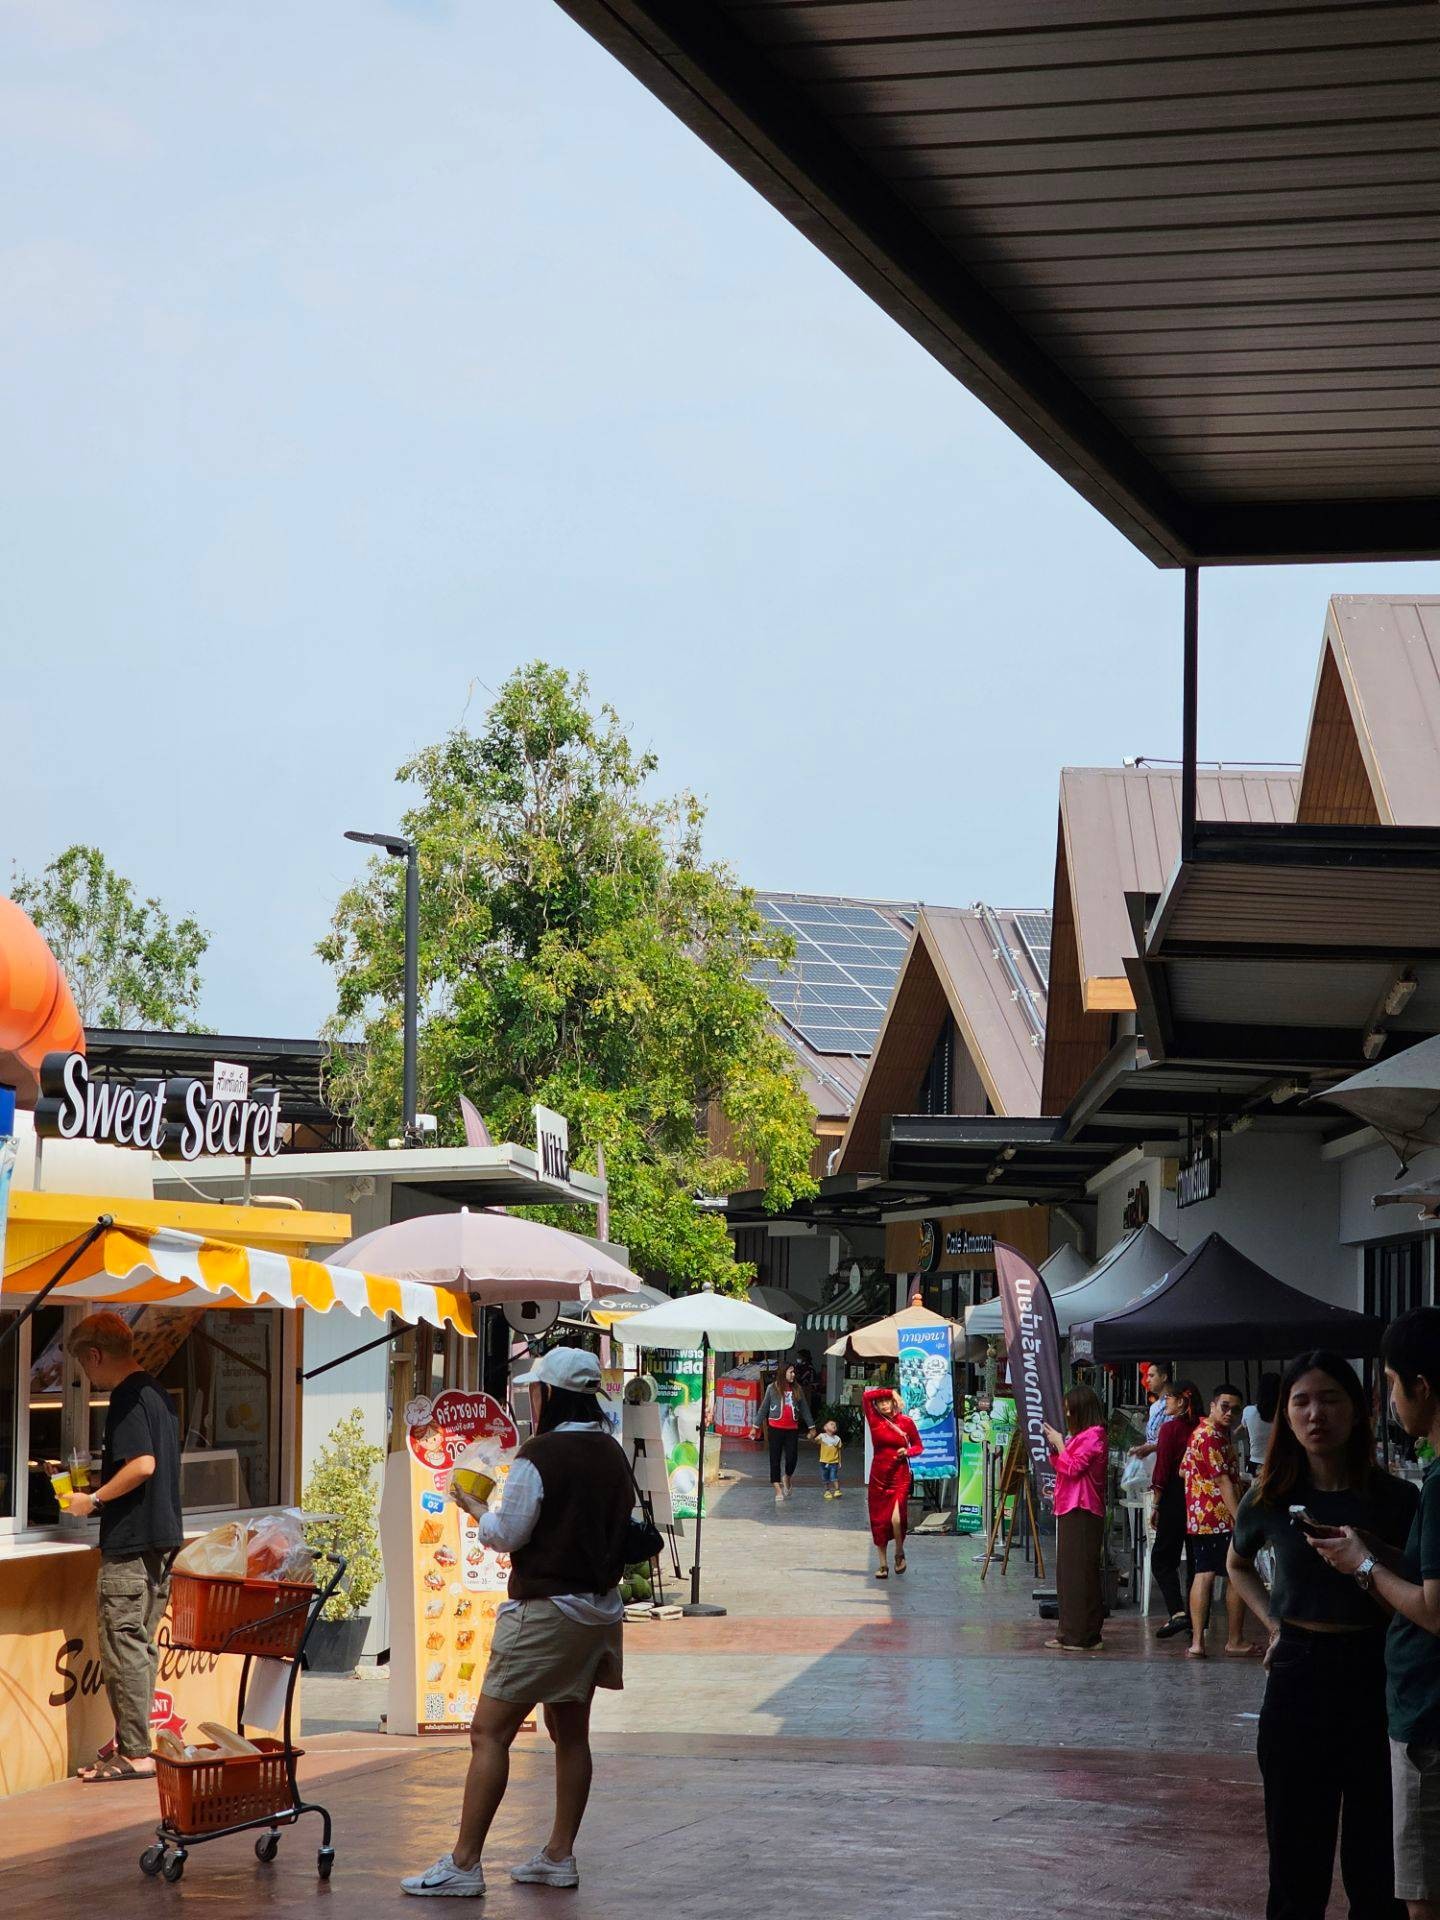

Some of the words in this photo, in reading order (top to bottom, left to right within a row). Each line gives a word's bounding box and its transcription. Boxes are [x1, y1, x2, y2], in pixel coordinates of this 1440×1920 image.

[58, 1053, 167, 1150] Sweet
[181, 1080, 282, 1161] Secret
[946, 1229, 962, 1254] Café
[962, 1231, 993, 1254] Amazon
[436, 1396, 488, 1425] ครัวซองต์
